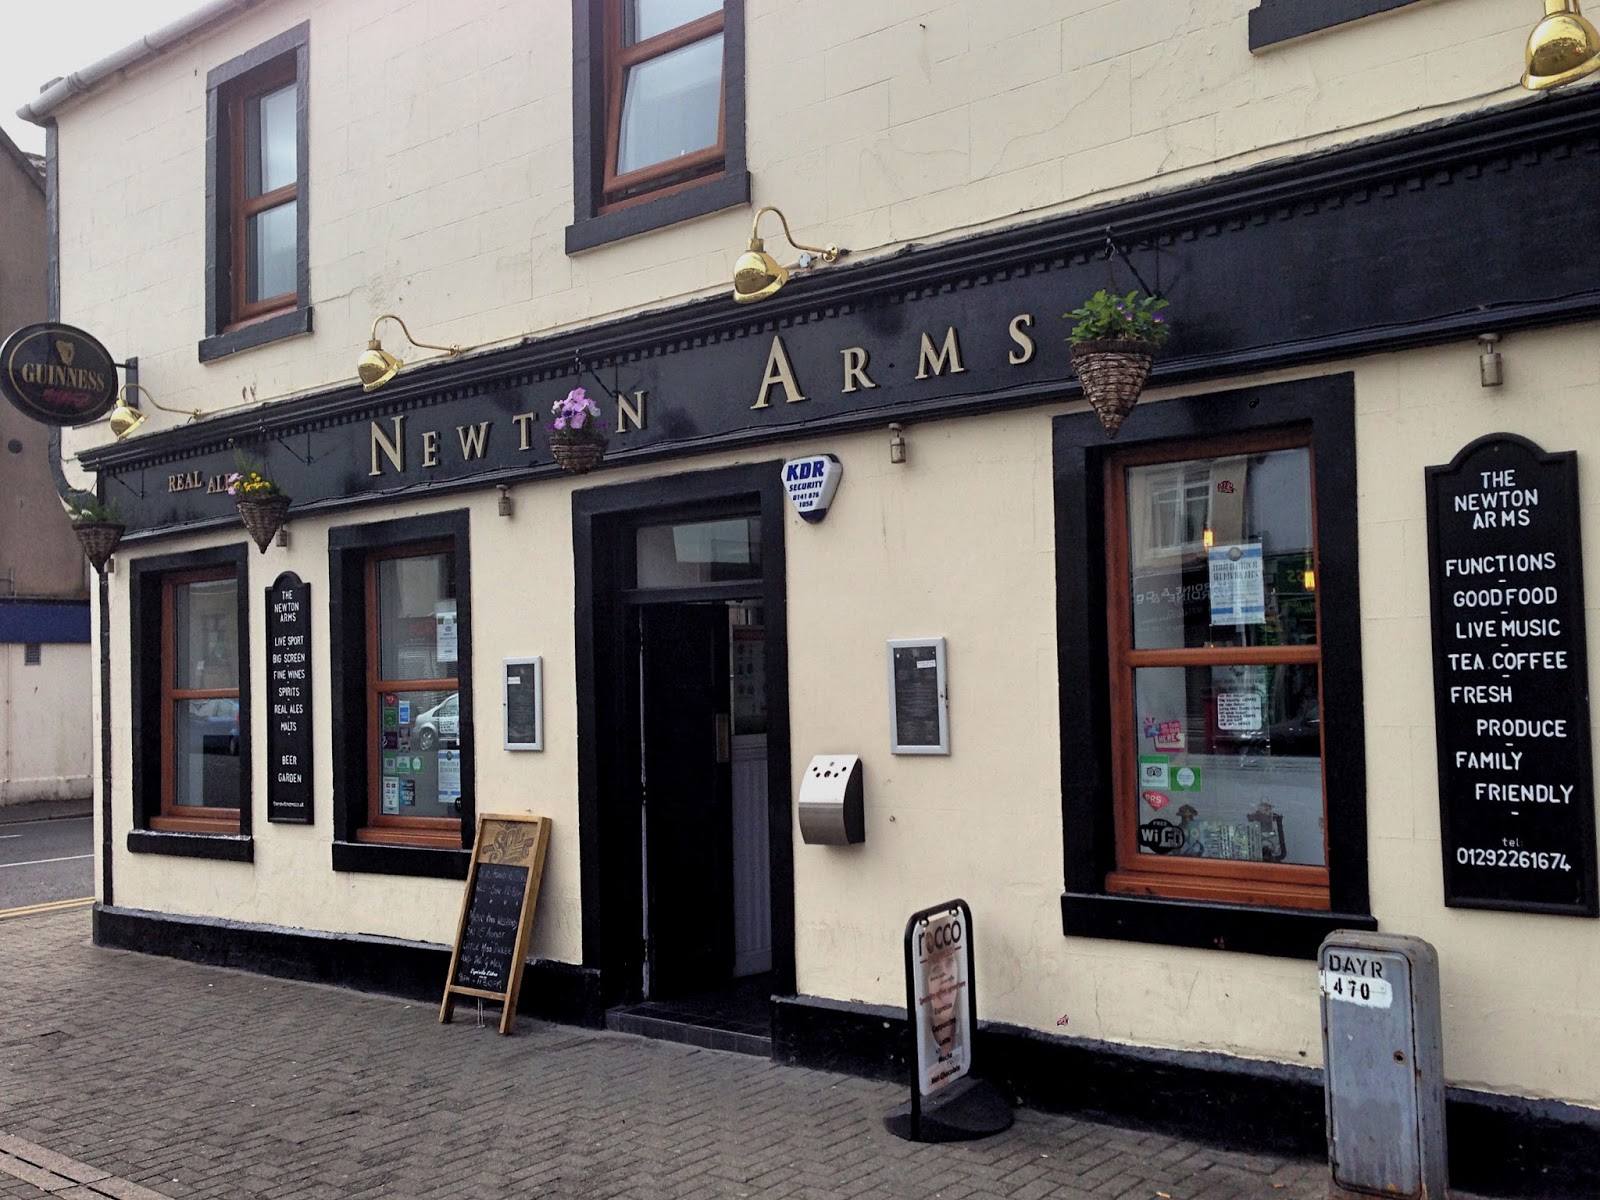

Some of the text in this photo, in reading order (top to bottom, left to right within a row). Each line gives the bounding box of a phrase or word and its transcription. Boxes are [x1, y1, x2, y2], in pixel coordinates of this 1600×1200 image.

[21, 362, 105, 393] GUINNESS
[368, 313, 1034, 476] NEWTN ARMS
[786, 460, 825, 482] KDR
[1480, 469, 1516, 489] THE
[168, 470, 202, 493] REAL
[789, 480, 824, 492] SECURITY
[1454, 488, 1539, 512] NEWTON
[1472, 509, 1531, 530] ARMS
[1445, 552, 1557, 577] FUNCTIONS
[281, 589, 293, 600] THE
[1453, 586, 1558, 608] GOOD FOOD
[274, 601, 300, 613] NEWTON
[279, 612, 297, 622] ARMS
[1456, 618, 1561, 639] LIVE MUSIC
[274, 635, 304, 646] LIVE SPORT
[272, 652, 306, 664] BIG SCREEN
[1492, 651, 1568, 670] COFFEE
[273, 669, 306, 680] FINE WINES
[278, 686, 301, 697] SPIRITS
[1450, 685, 1513, 704] FRESH
[274, 703, 304, 714] REAL ALES
[280, 721, 297, 732] MALTS
[1476, 719, 1568, 738] PRODUCE
[281, 754, 298, 765] BEER
[1455, 751, 1523, 771] FAMILY
[277, 772, 303, 783] GARDEN
[1475, 783, 1574, 804] FRIENDLY
[1456, 847, 1572, 872] 01292261674
[918, 919, 962, 957] rocco
[1328, 954, 1383, 979] DAYR
[1333, 977, 1370, 1001] 470
